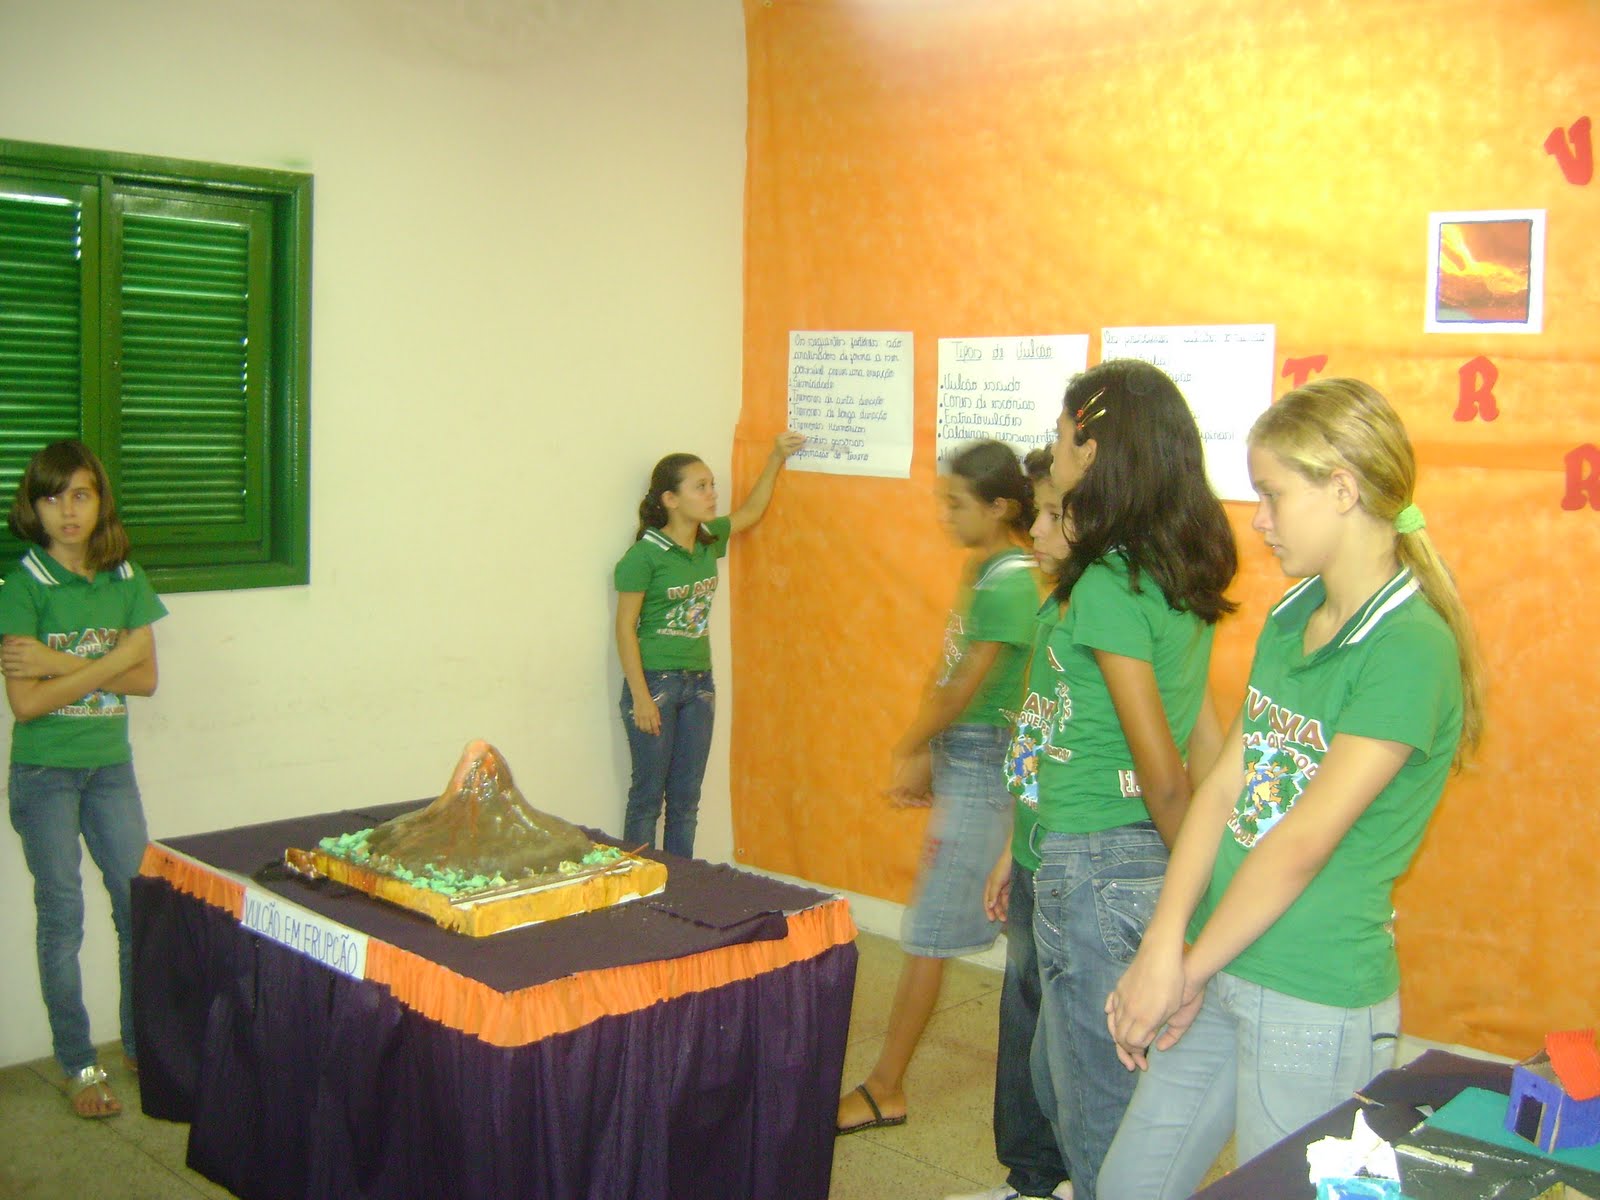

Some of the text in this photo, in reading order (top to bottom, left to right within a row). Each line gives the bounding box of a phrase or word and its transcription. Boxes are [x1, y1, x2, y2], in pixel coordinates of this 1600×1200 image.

[1544, 116, 1593, 186] V
[952, 341, 982, 362] Tipos
[992, 344, 1004, 359] de
[976, 394, 987, 409] de
[1453, 356, 1499, 422] R
[79, 627, 118, 647] AM
[1246, 685, 1272, 723] V
[245, 897, 281, 939] VULCÃO
[284, 915, 300, 951] EM
